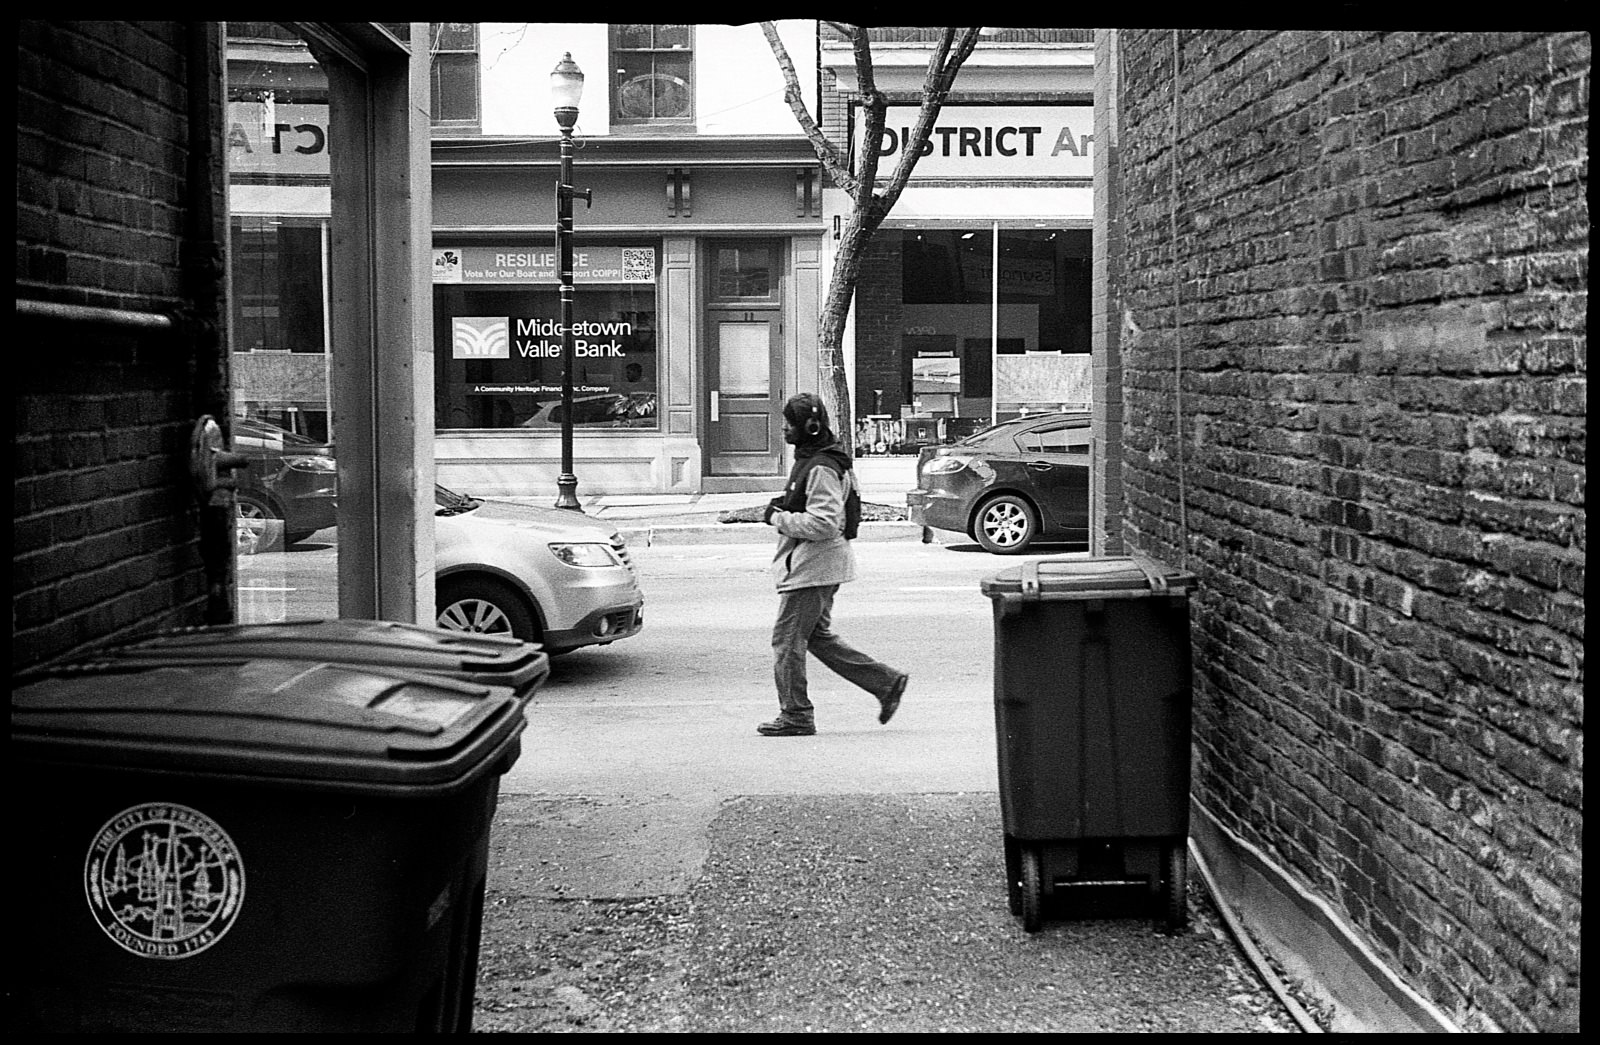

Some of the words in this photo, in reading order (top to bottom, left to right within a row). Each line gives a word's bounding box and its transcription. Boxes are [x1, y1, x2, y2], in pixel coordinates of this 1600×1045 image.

[495, 253, 589, 268] RESILIECE
[464, 269, 484, 278] Vote
[485, 269, 497, 278] for
[499, 269, 515, 278] Our
[516, 269, 537, 278] Boat
[538, 269, 555, 278] and
[516, 318, 632, 337] Middetown
[515, 339, 564, 358] Valle
[574, 339, 627, 358] Bank.
[480, 385, 514, 394] Community
[514, 385, 541, 394] Heritage
[541, 385, 563, 393] Financi
[581, 385, 610, 394] Company
[115, 810, 145, 832] CITY
[106, 921, 179, 956] FOUNDED
